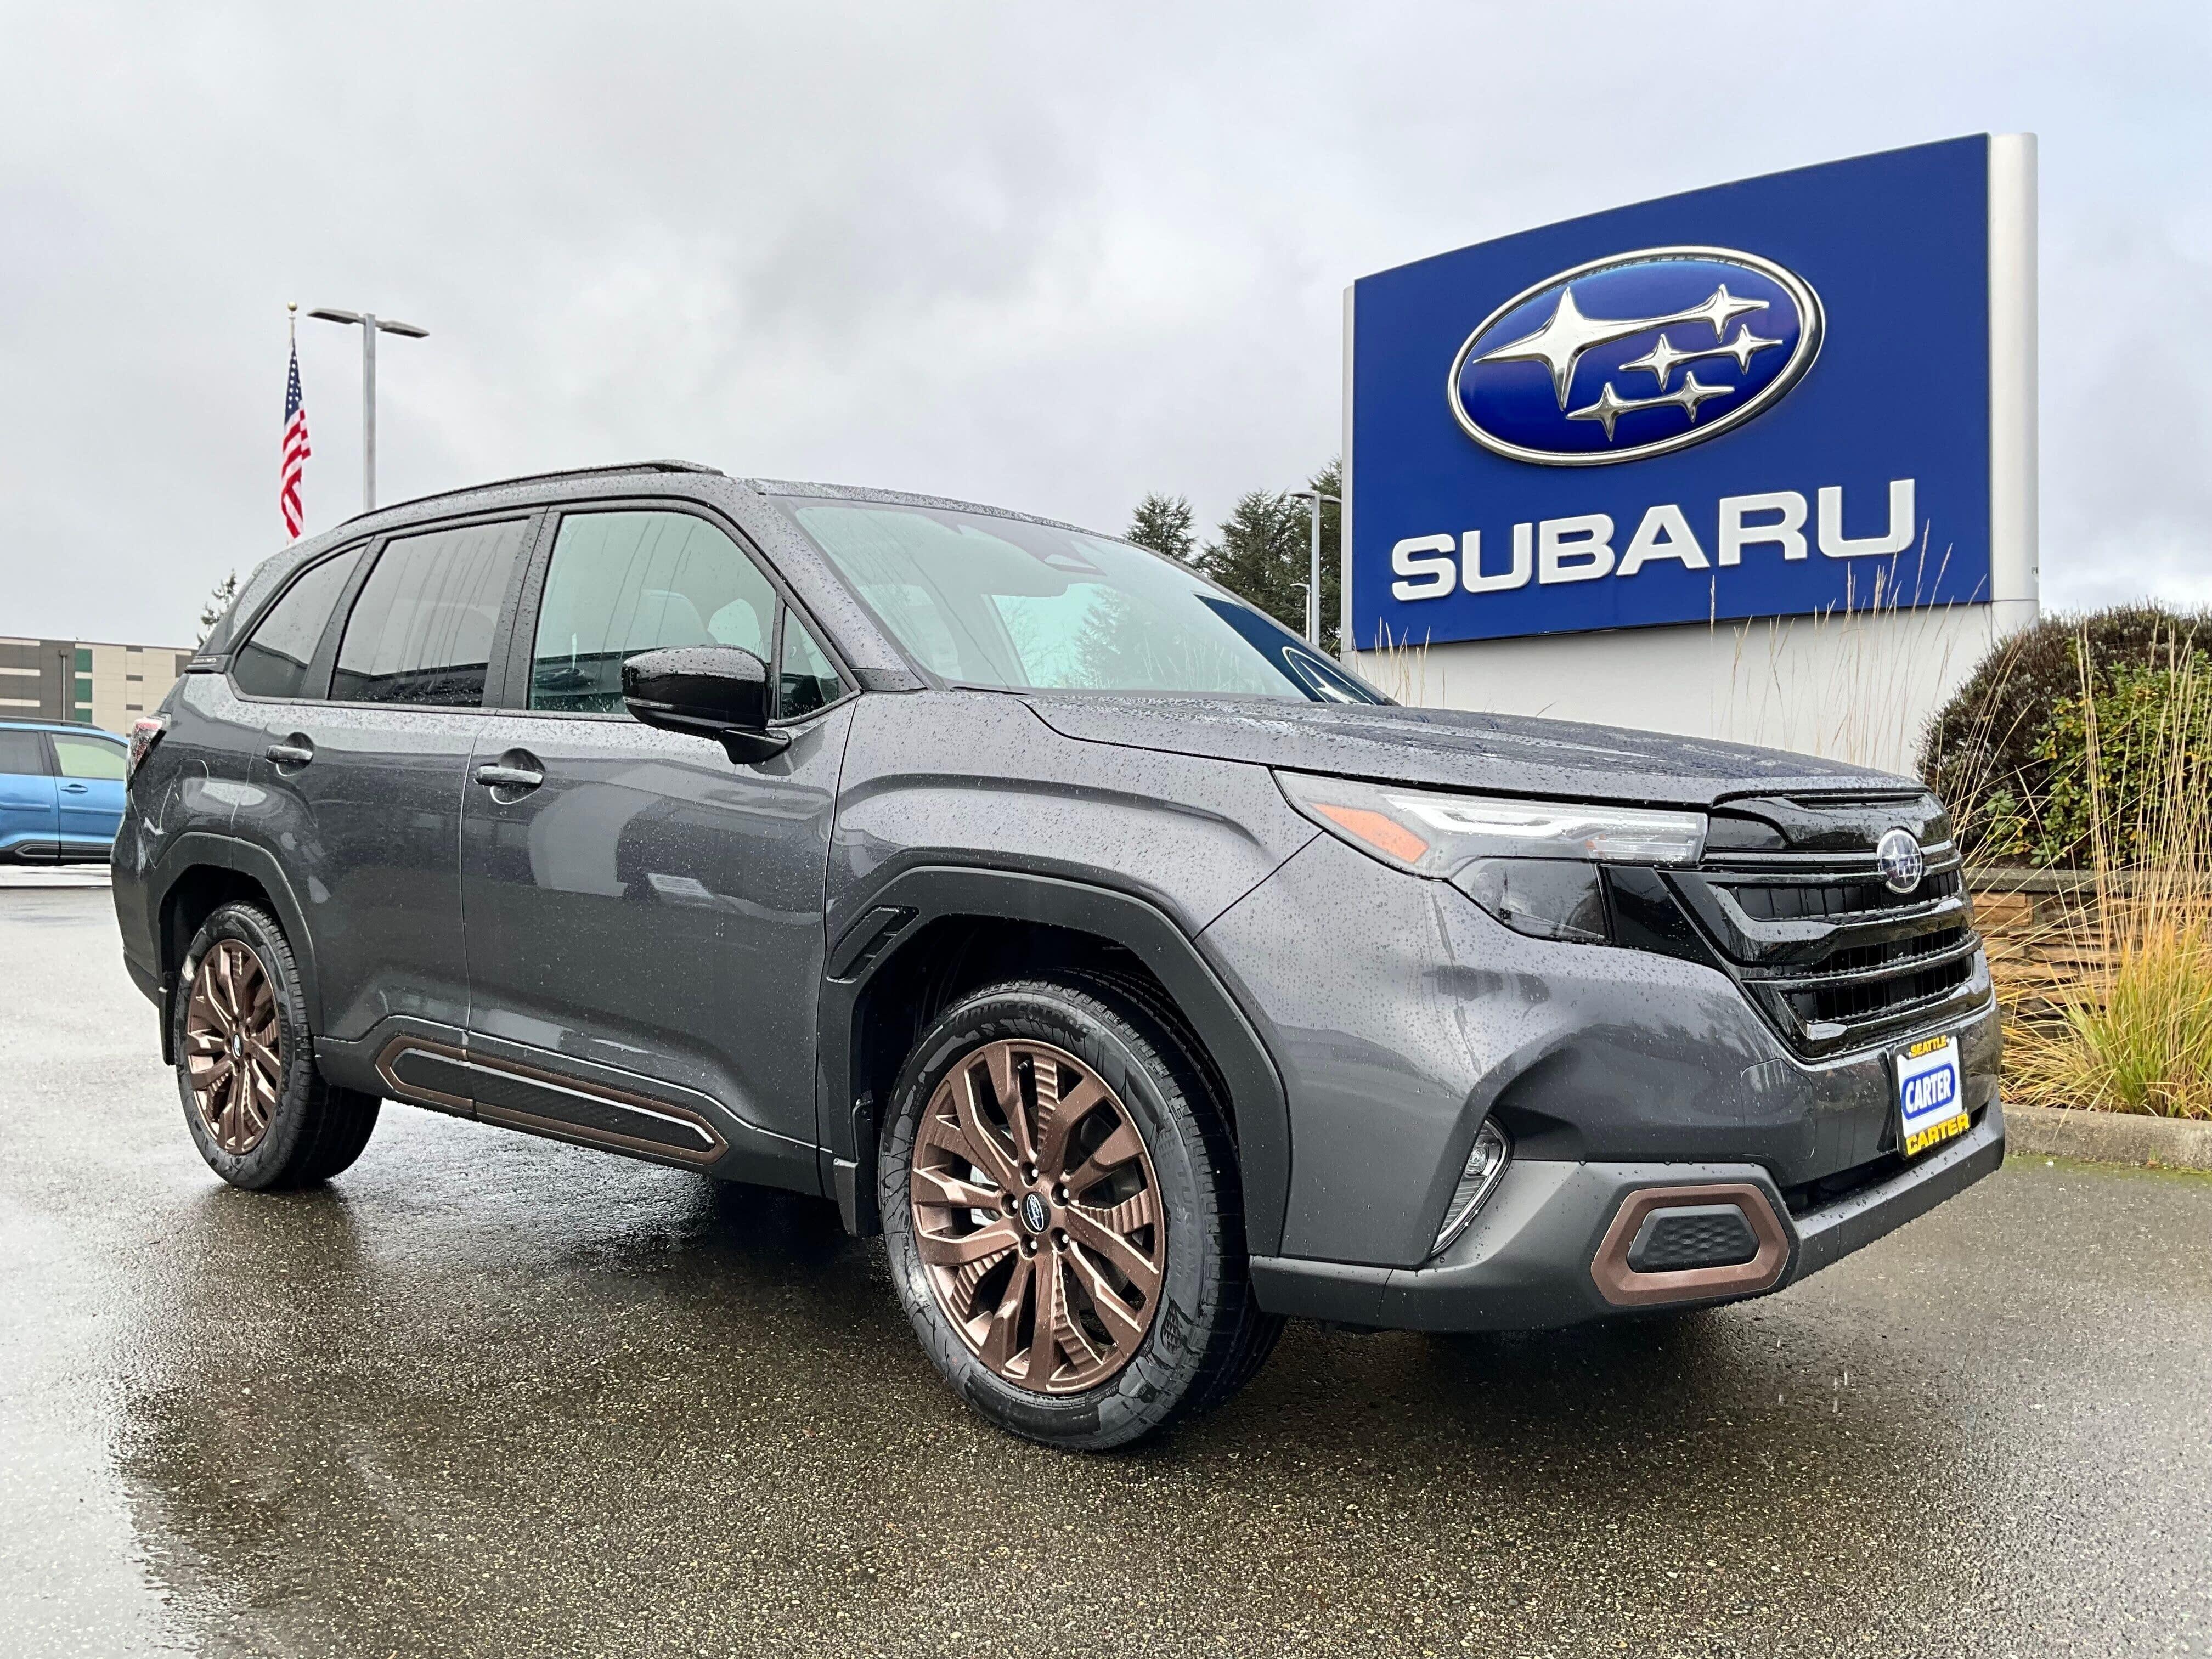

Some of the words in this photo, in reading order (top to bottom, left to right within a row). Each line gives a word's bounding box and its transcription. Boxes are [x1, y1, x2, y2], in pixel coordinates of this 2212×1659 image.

[1391, 478, 1916, 601] SUBARU
[1910, 1035, 1948, 1057] SEATTLE
[1905, 1069, 1952, 1114] CARTER
[1906, 1112, 1970, 1156] CARTER
